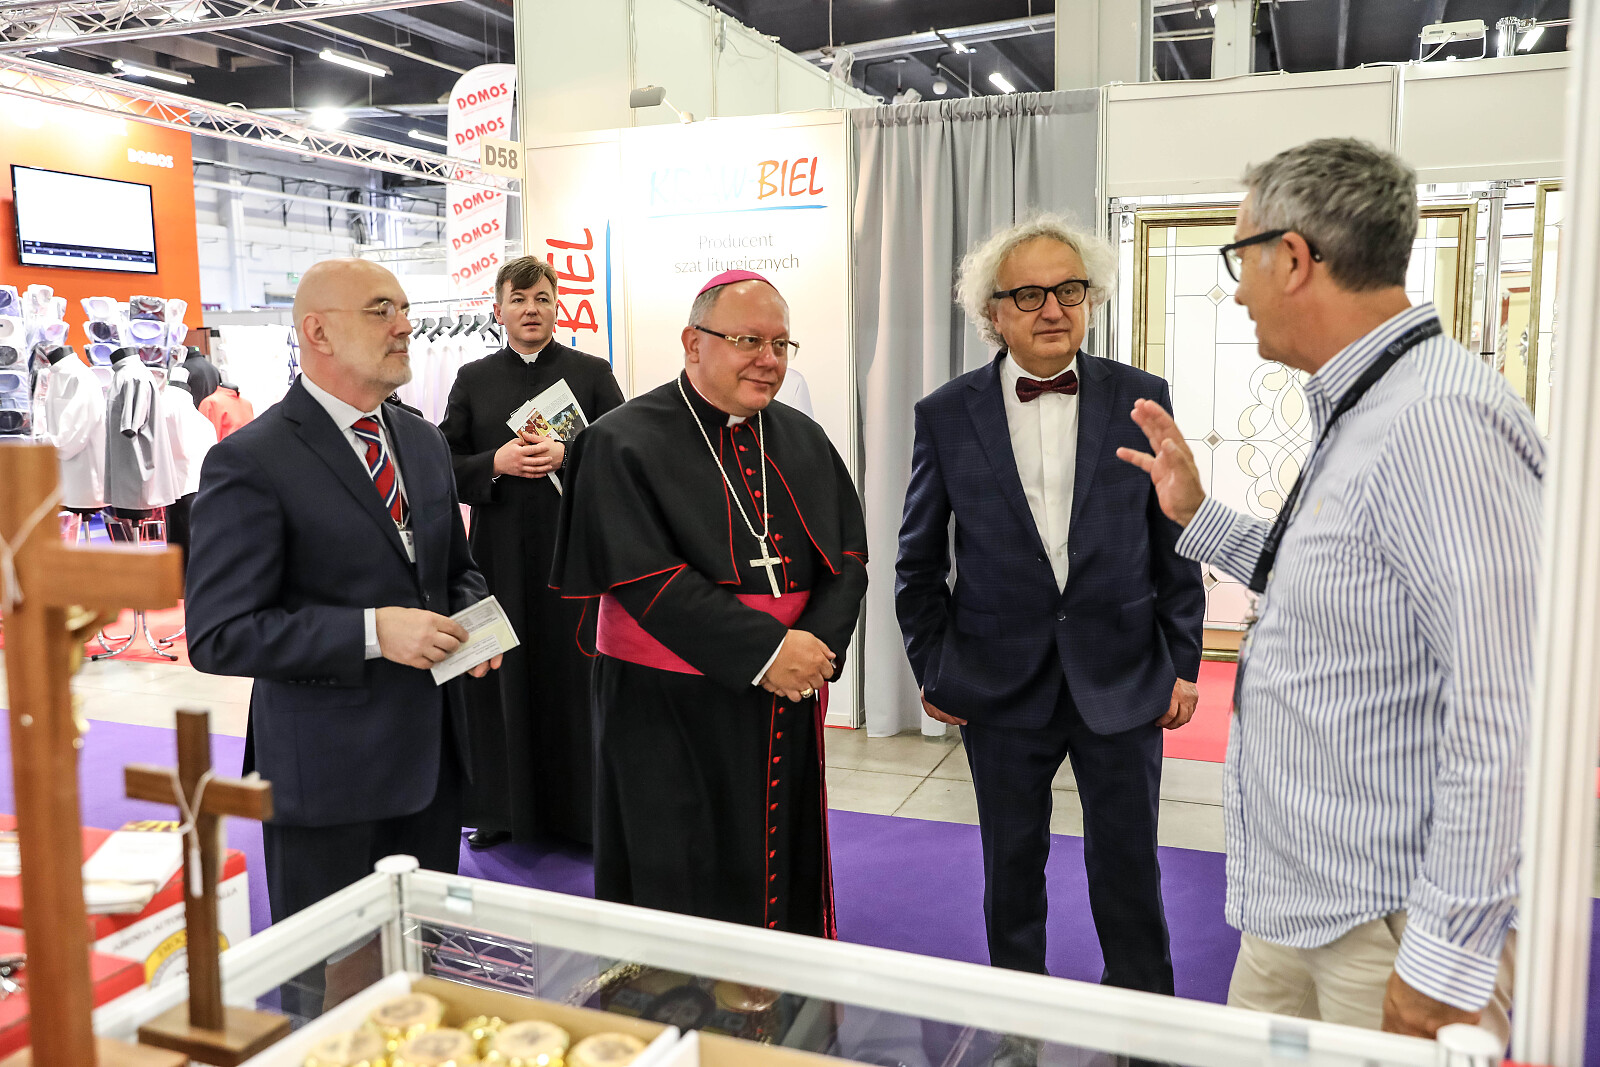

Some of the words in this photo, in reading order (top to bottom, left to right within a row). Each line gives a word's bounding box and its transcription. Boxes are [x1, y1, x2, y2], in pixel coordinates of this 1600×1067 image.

[456, 82, 508, 110] DOMOS
[455, 116, 505, 145] DOMOS
[127, 147, 174, 168] DOMOS
[485, 144, 518, 170] D58
[451, 218, 500, 251] DOMOS
[699, 233, 774, 250] Producent
[451, 252, 499, 286] DOMOS
[674, 260, 702, 273] szat
[707, 253, 799, 273] liturgicznych
